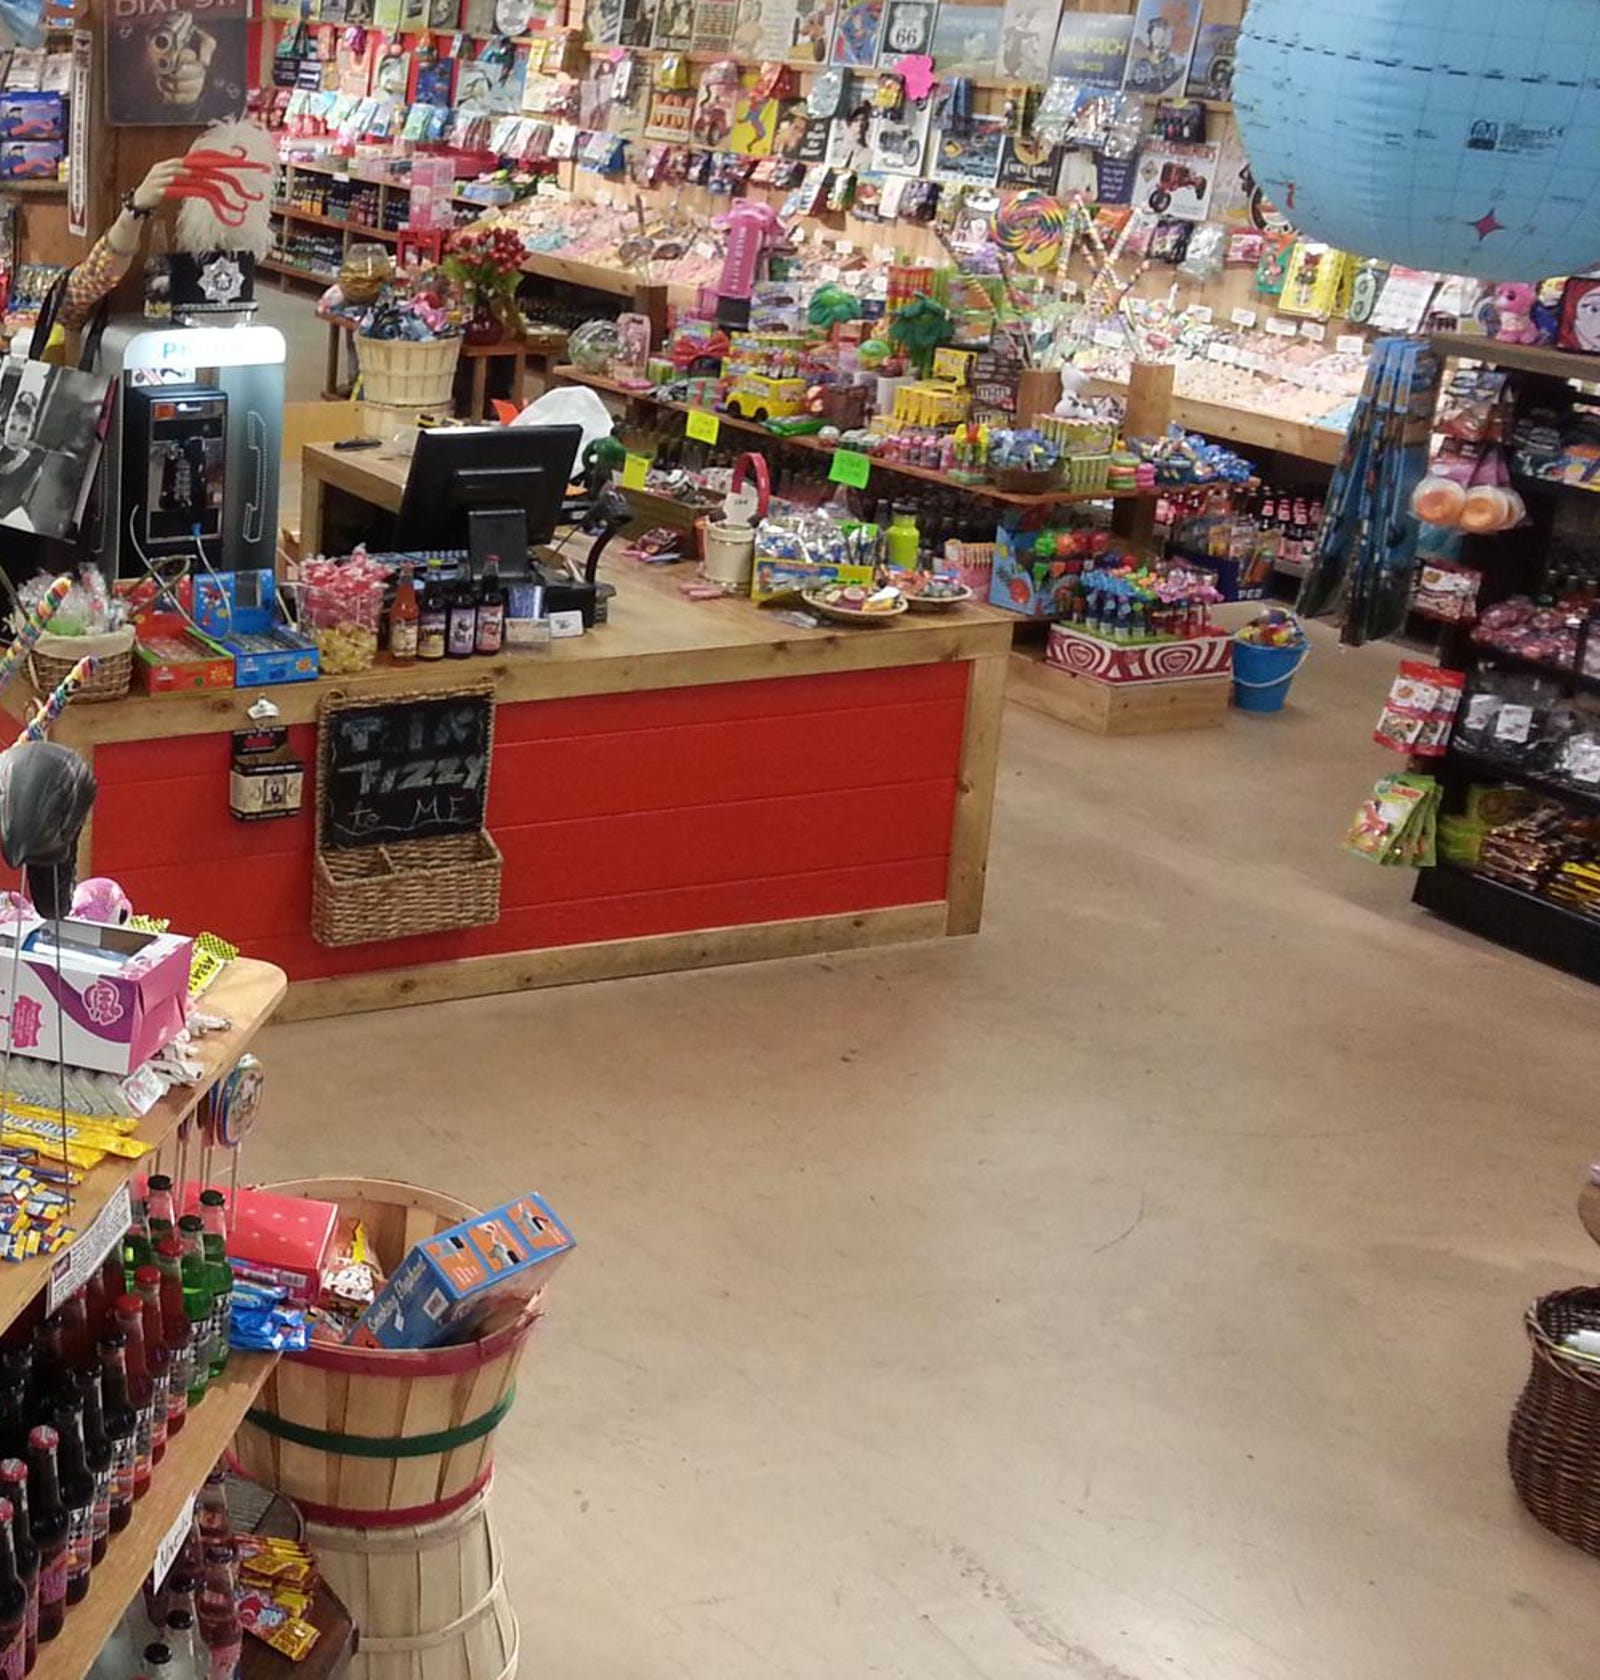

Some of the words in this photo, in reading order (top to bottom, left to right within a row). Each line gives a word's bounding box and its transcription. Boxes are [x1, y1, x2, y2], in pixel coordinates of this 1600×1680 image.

[895, 27, 918, 44] 66
[348, 801, 381, 830] to
[412, 795, 465, 825] ME
